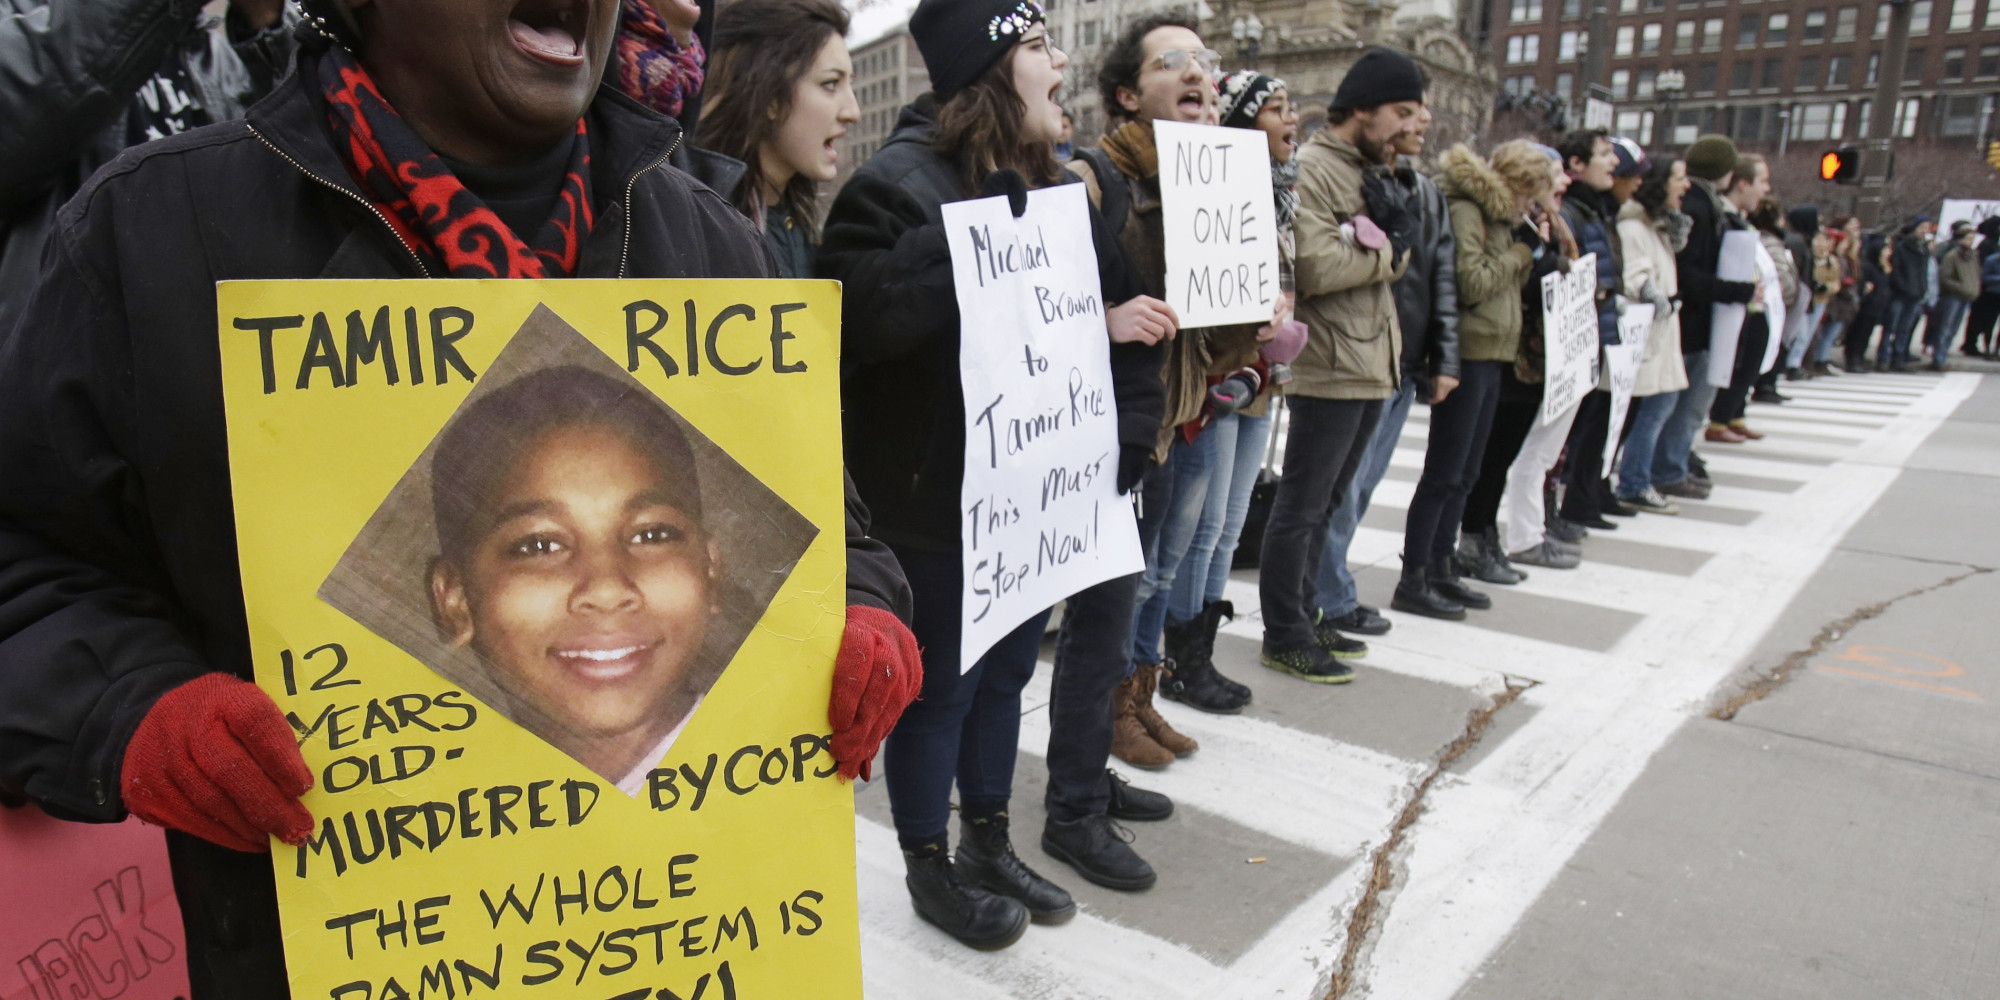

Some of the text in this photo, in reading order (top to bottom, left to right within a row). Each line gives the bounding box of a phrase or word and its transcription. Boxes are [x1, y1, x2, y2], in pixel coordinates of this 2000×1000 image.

[1176, 141, 1233, 186] NOT
[1194, 201, 1257, 244] ONE
[968, 223, 1052, 288] Michael
[1034, 285, 1098, 325] Brown
[1187, 261, 1270, 314] MORE
[233, 299, 808, 395] TAMIR RICE
[1021, 344, 1048, 377] to
[975, 367, 1106, 469] Tamir Rice
[968, 493, 1020, 551] This
[973, 499, 1099, 623] Stop Now!
[280, 642, 362, 697] 12
[285, 690, 478, 751] YEARS
[295, 733, 839, 879] MURDERED BY COPS
[324, 853, 699, 960] THE WHOLE
[521, 906, 760, 987] SYSTEM
[779, 889, 824, 936] IS
